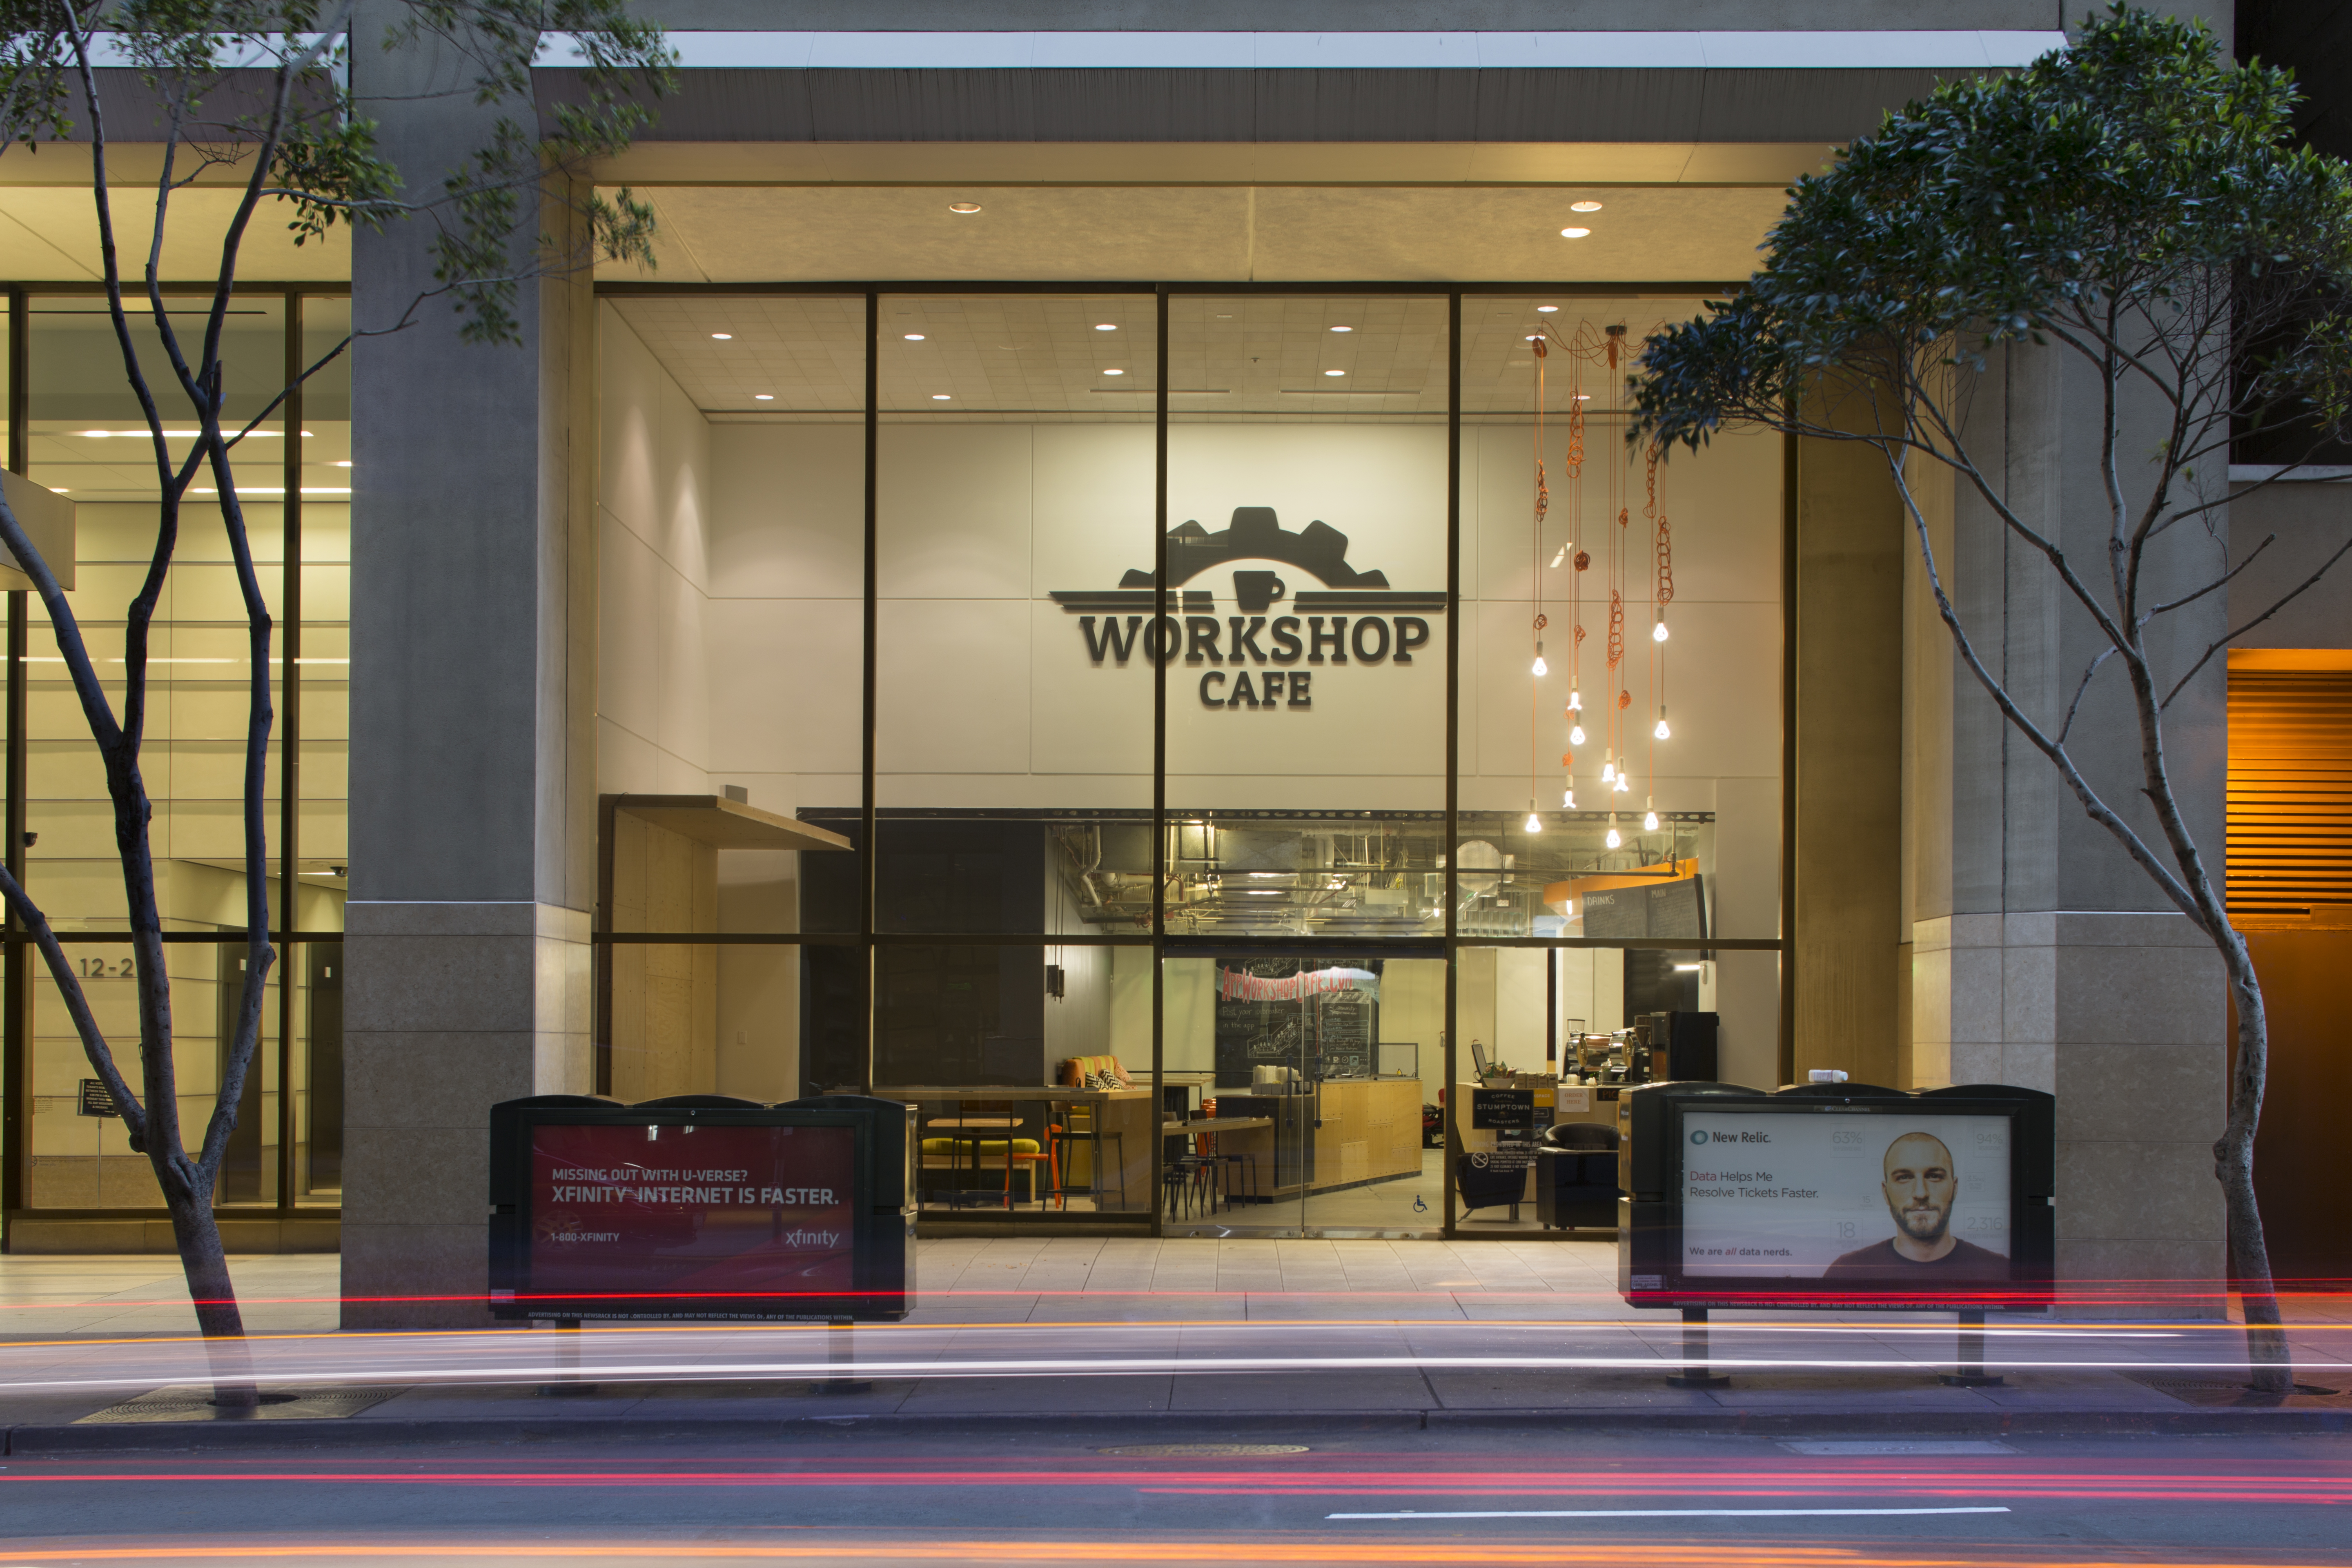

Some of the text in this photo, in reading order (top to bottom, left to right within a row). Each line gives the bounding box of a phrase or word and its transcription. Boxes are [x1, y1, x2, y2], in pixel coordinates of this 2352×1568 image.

[1079, 616, 1429, 662] WORKSHOP
[1200, 671, 1312, 706] CAFE
[1651, 888, 1666, 898] MAIN
[1587, 894, 1615, 906] DRINKS
[1222, 1005, 1285, 1021] Post your icebreaker
[1713, 1131, 1738, 1143] New
[1833, 1131, 1862, 1144] 63%
[1976, 1133, 2003, 1144] 94%
[552, 1169, 748, 1181] MISSING OUT WITH U-VERSE?
[1690, 1171, 1772, 1183] Data Helps Me
[638, 1187, 733, 1203] INTERNET
[739, 1187, 755, 1203] IS
[761, 1188, 839, 1204] FASTER.
[1690, 1187, 1819, 1198] Resolve Tickets Faster.
[1836, 1221, 1855, 1238] 18
[1967, 1217, 2003, 1231] 2,316
[551, 1232, 620, 1242] 1-800-XFINITY
[786, 1229, 840, 1248] xfinity
[1689, 1247, 1704, 1256] We
[1725, 1247, 1737, 1256] all
[1740, 1247, 1760, 1256] data
[1764, 1248, 1792, 1256] nerds.
